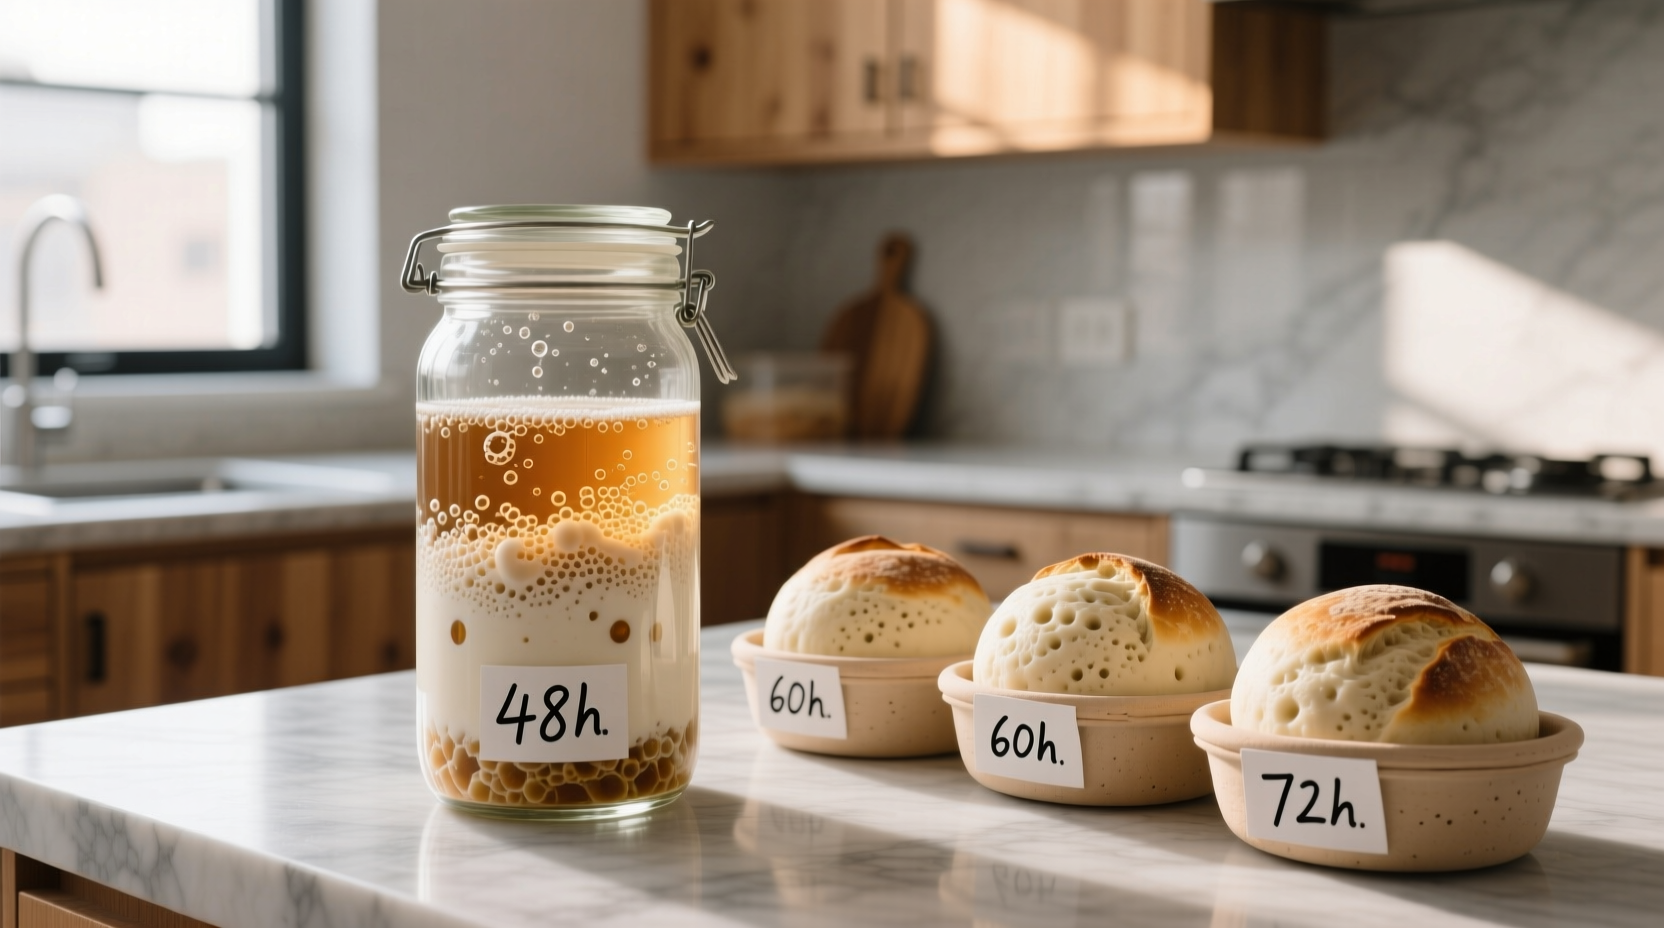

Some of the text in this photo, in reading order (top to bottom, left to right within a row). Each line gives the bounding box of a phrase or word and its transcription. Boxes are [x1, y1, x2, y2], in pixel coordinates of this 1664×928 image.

[495, 681, 609, 745] 48h.
[769, 675, 832, 719] 60h.
[990, 715, 1066, 766] 60h.
[1261, 773, 1366, 829] 72h.
